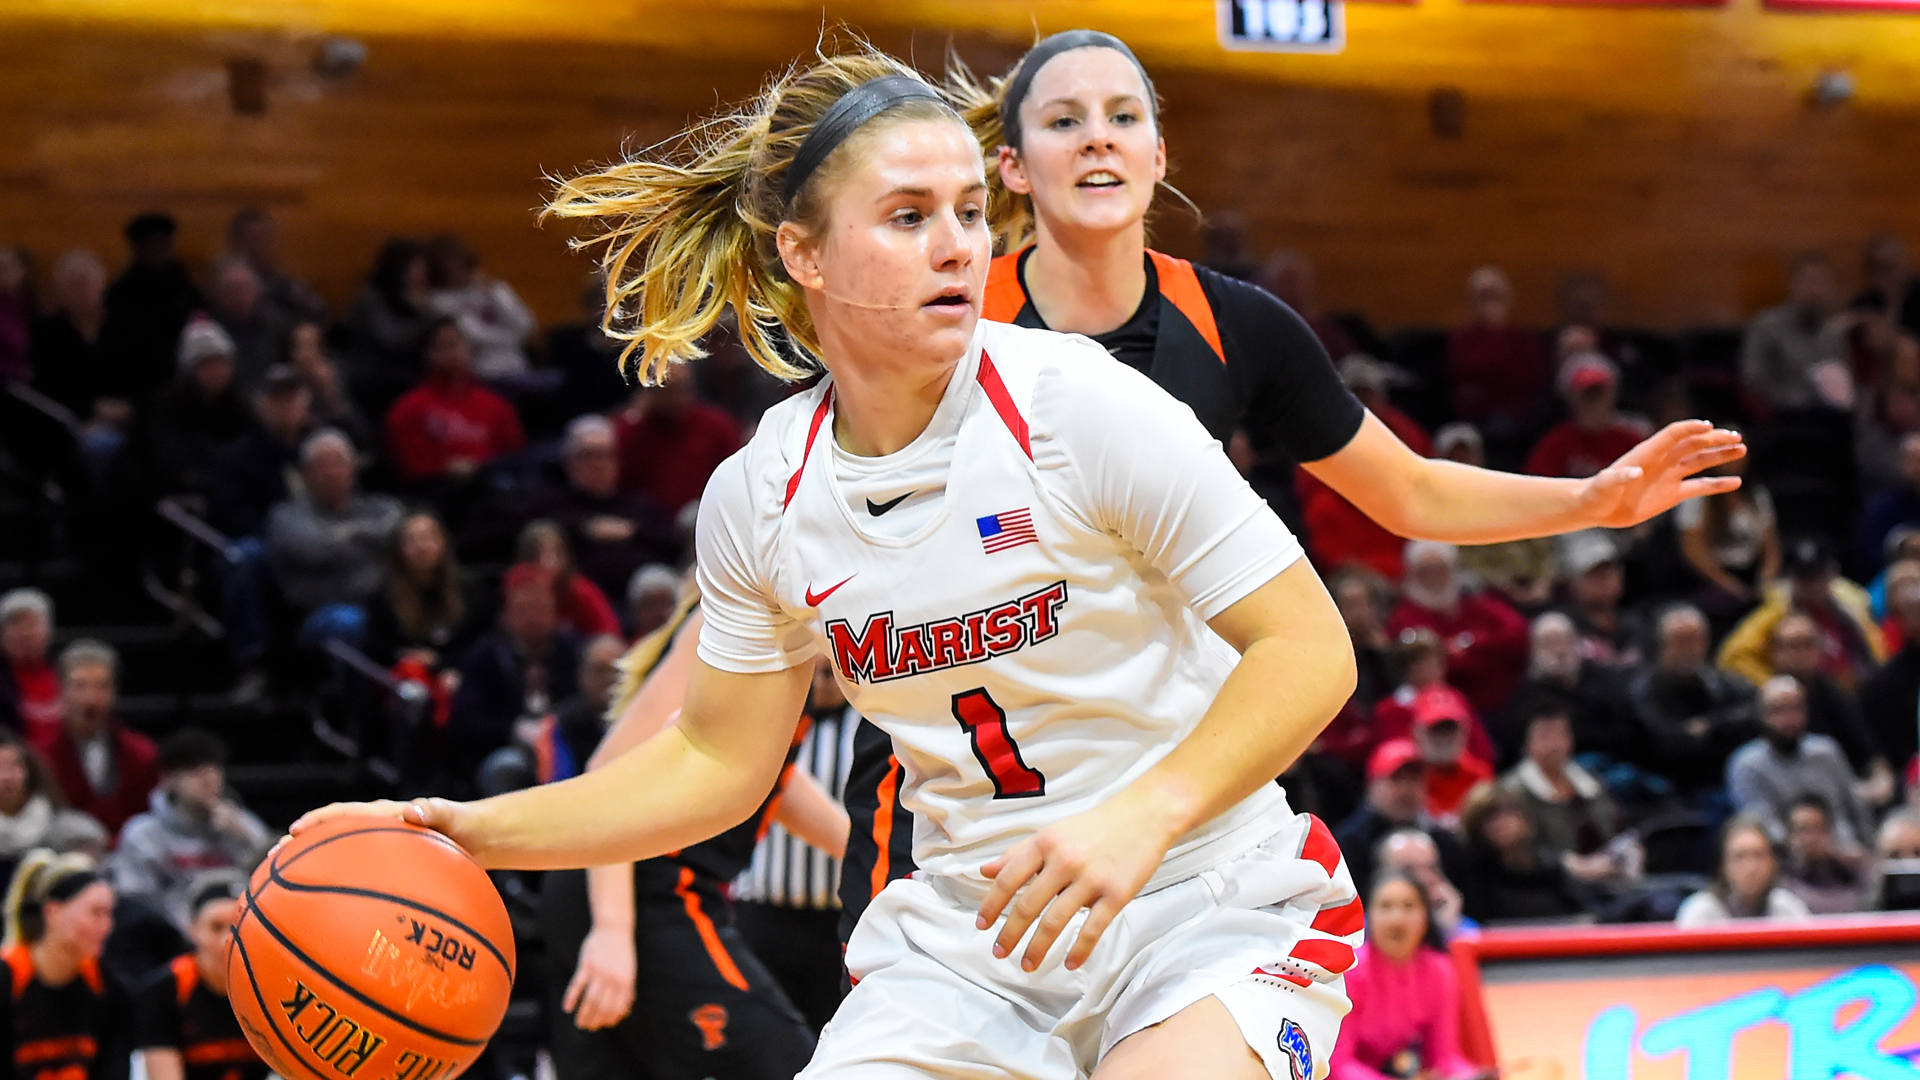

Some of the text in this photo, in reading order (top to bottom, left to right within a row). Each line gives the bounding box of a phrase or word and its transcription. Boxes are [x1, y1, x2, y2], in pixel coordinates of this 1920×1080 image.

[825, 579, 1068, 685] MARIST
[951, 686, 1046, 800] 1
[405, 917, 476, 971] ROCK
[280, 979, 388, 1078] ROCK
